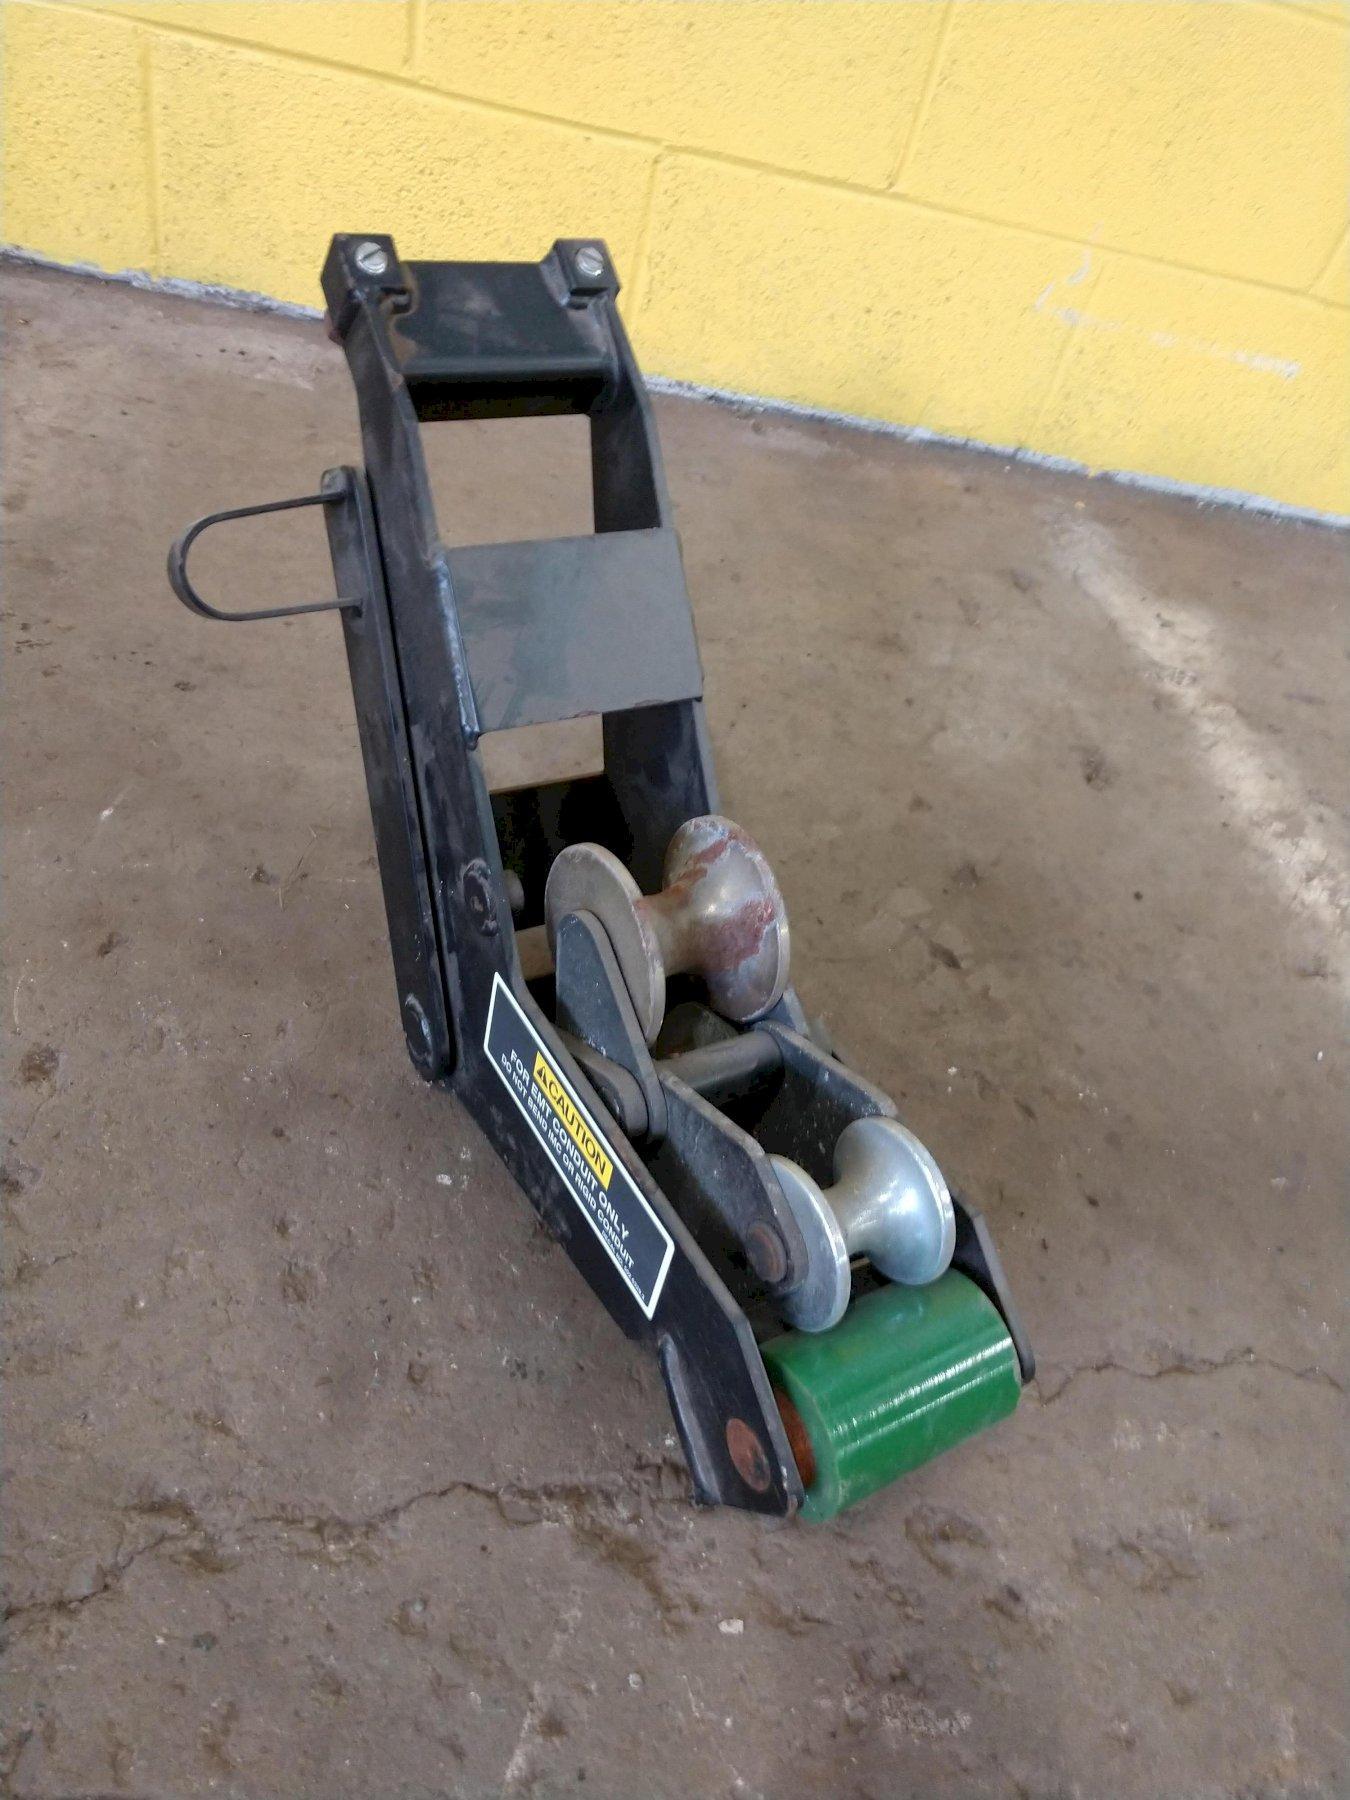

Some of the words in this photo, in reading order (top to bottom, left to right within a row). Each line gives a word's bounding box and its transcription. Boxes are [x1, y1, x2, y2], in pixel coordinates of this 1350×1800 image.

[501, 1051, 512, 1076] DO
[512, 1069, 527, 1101] NOT
[527, 1093, 547, 1134] BEND
[547, 1126, 562, 1157] IMC
[562, 1150, 575, 1177] OR
[574, 1170, 597, 1213] RIGID
[596, 1206, 634, 1272] CONDUIT
[510, 1047, 530, 1088] FOR
[530, 1080, 551, 1122] EMT
[551, 1114, 598, 1196] CONDUIT
[597, 1187, 629, 1245] ONLY
[548, 1076, 606, 1176] CAUTION
